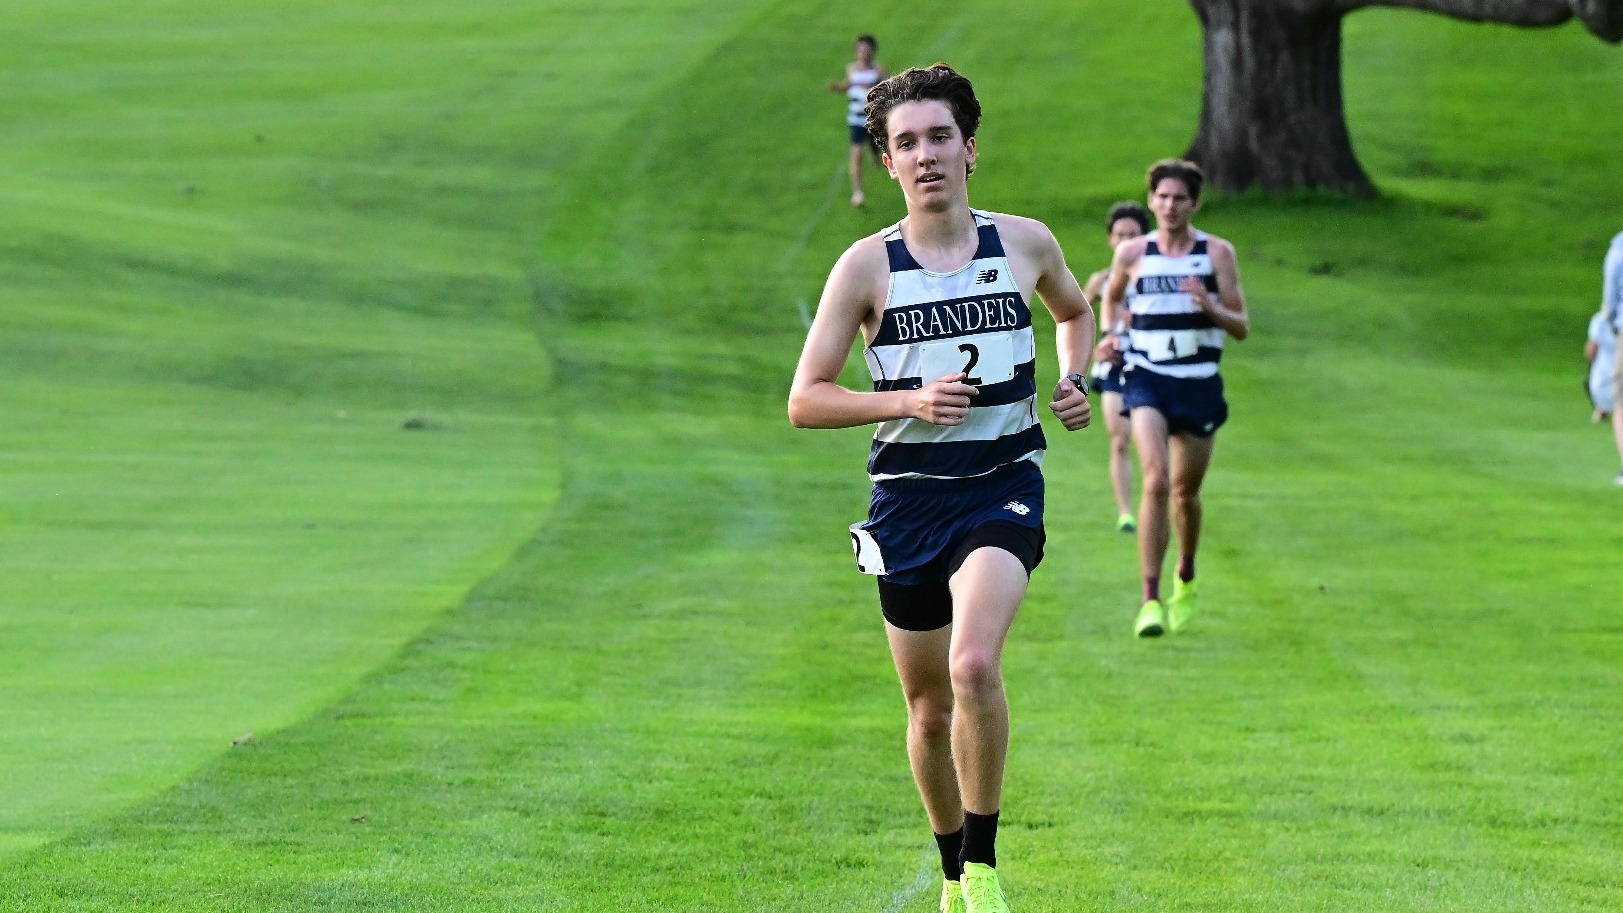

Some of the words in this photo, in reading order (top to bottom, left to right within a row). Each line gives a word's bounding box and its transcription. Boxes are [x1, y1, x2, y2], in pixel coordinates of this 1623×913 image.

[893, 297, 1018, 341] BRANDEIS
[958, 343, 983, 386] 2
[1167, 337, 1178, 359] 4
